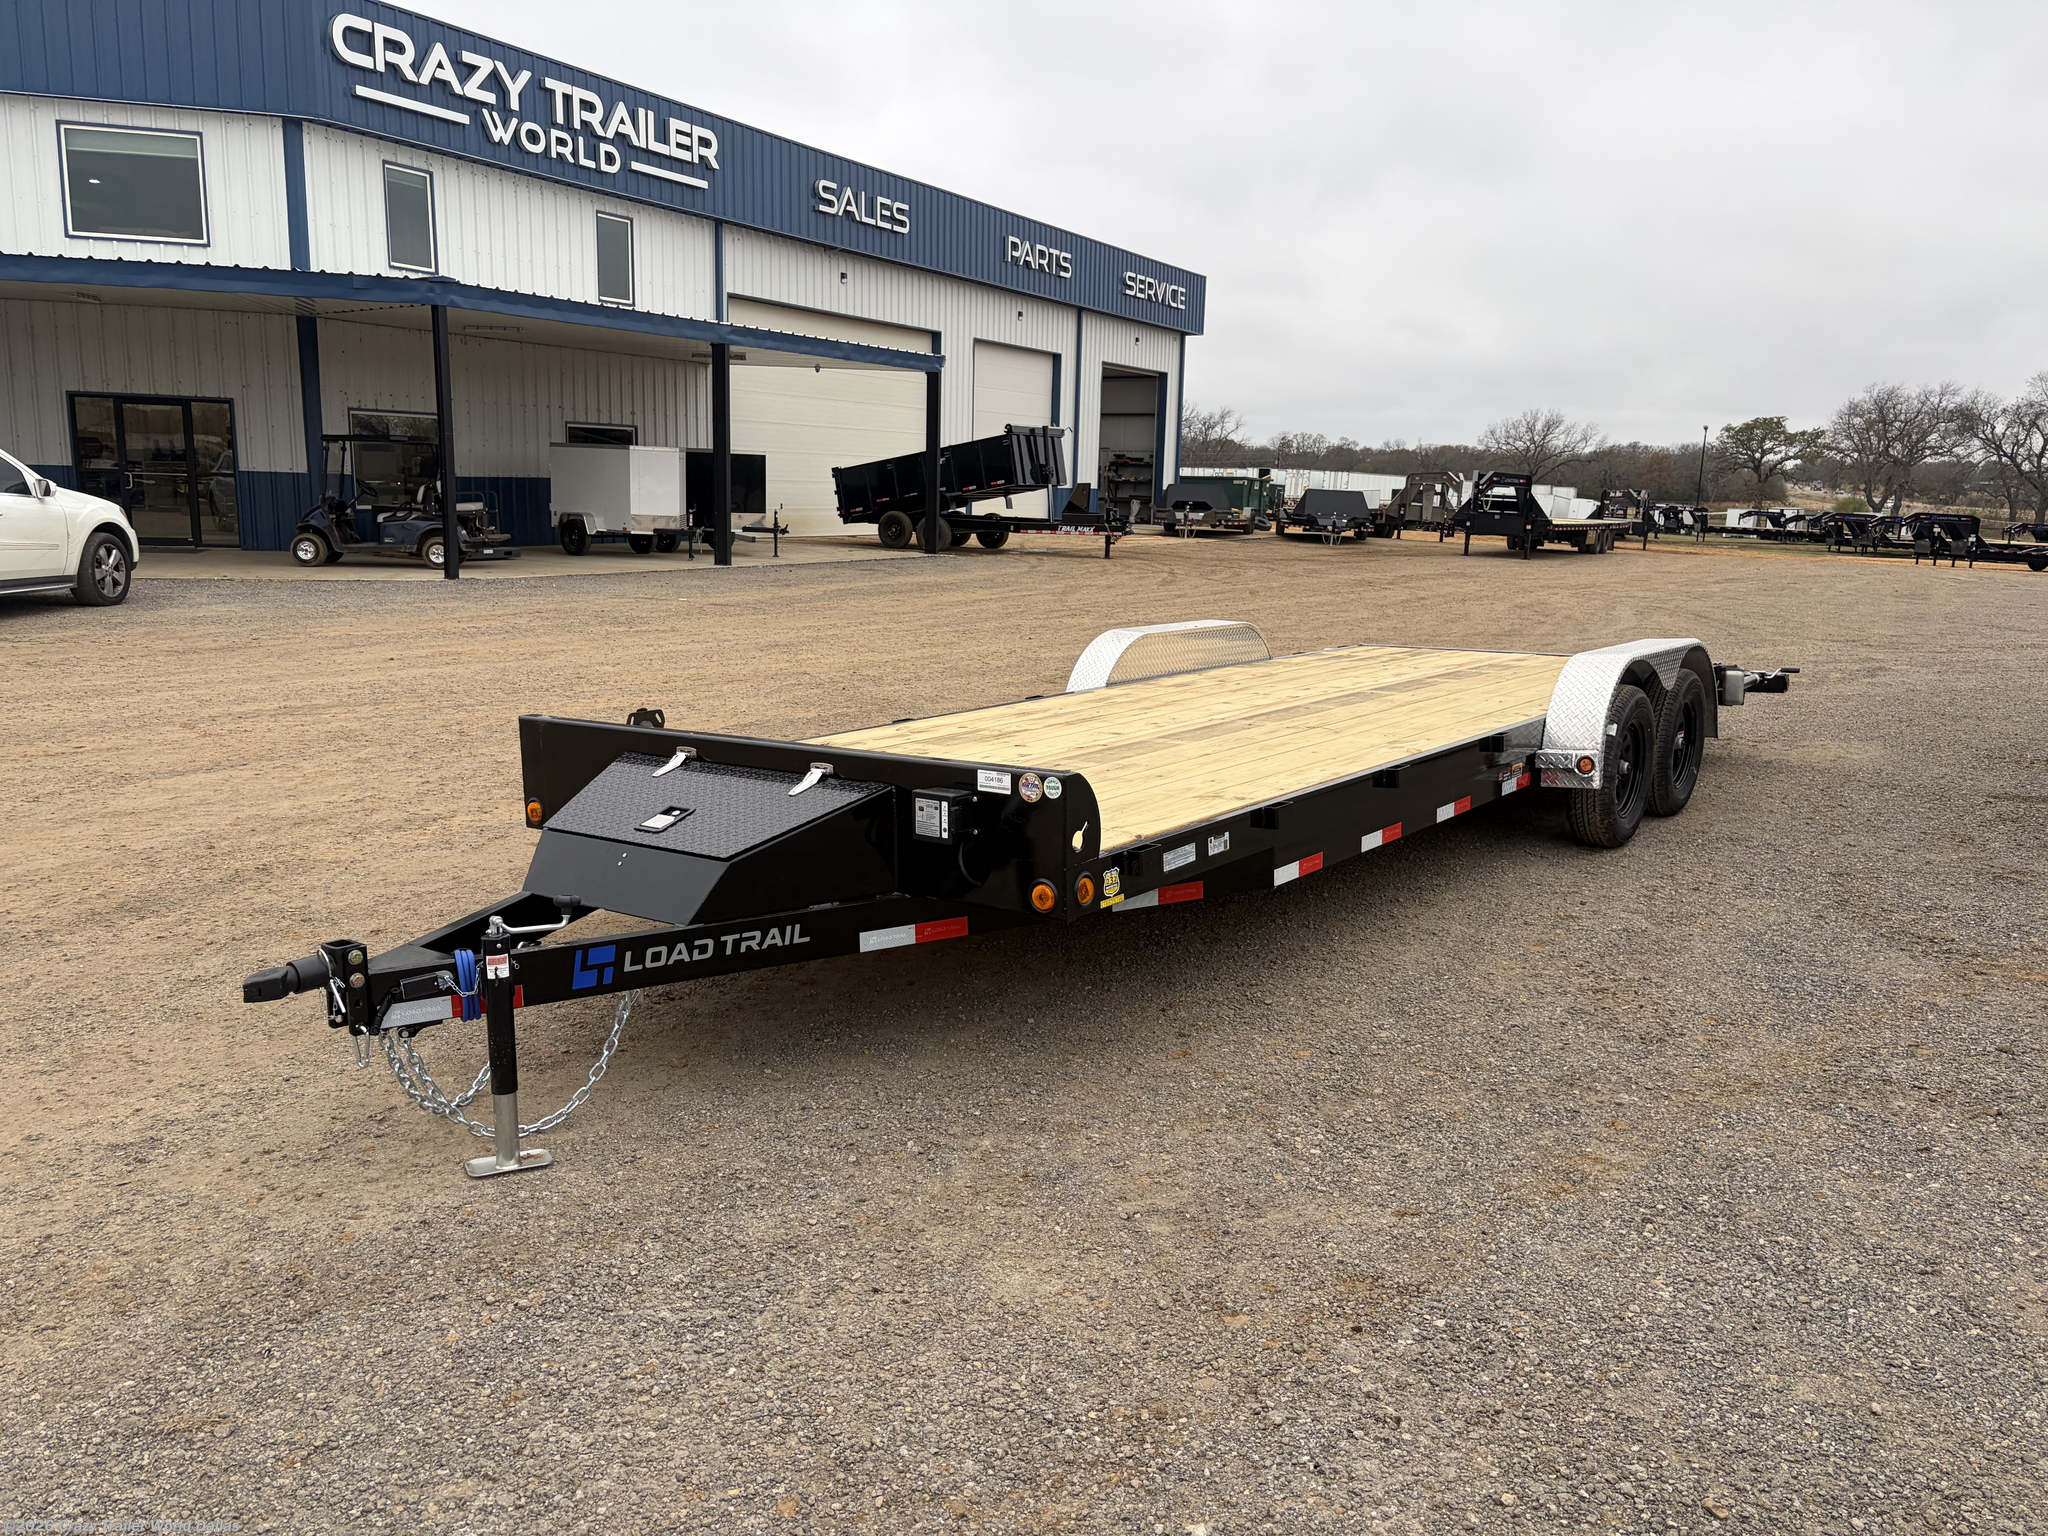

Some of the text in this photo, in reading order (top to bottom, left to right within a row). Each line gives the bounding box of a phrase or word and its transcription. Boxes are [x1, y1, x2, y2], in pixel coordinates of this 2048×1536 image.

[329, 12, 720, 170] CRAZY TRAILER
[482, 107, 622, 174] WORLD
[815, 179, 910, 234] SALES
[1005, 235, 1072, 279] PARTS
[1123, 271, 1186, 310] SERVICE
[623, 938, 714, 972] LOAD
[720, 923, 811, 956] TRAIL
